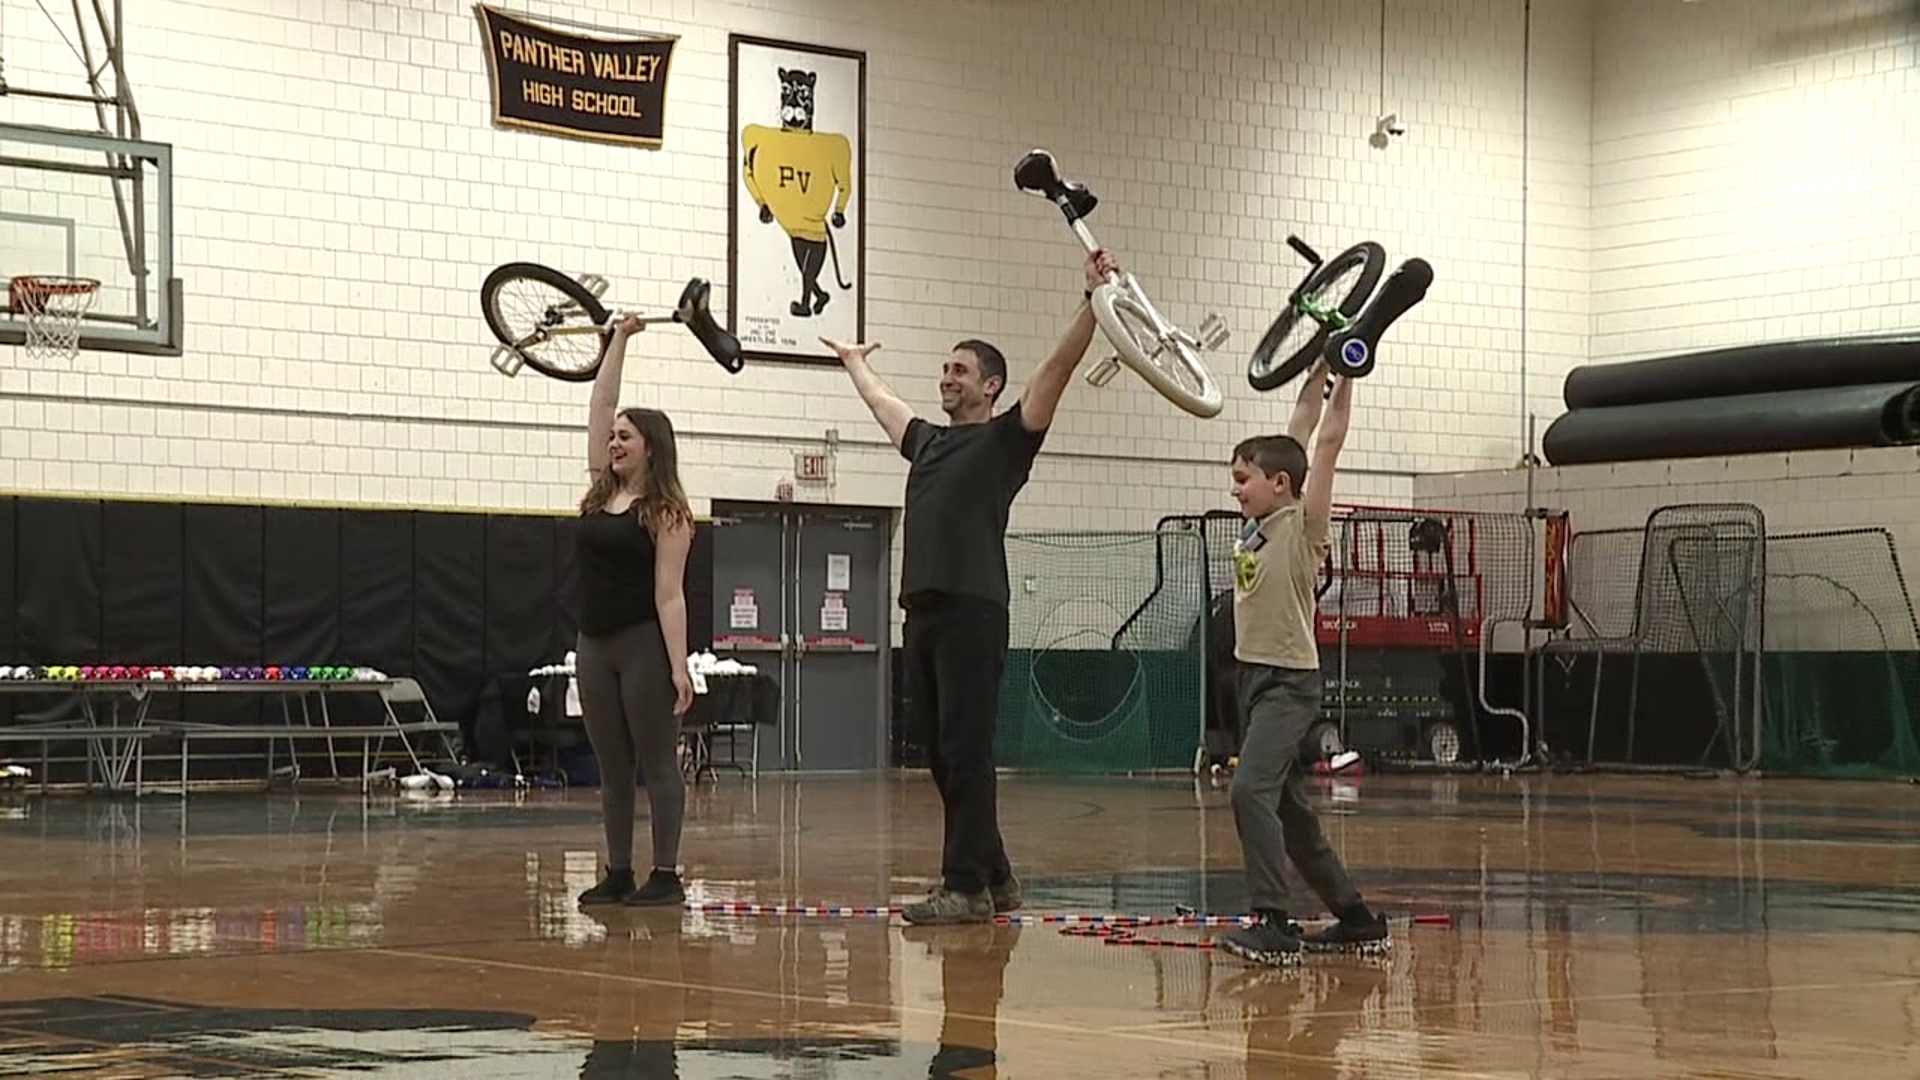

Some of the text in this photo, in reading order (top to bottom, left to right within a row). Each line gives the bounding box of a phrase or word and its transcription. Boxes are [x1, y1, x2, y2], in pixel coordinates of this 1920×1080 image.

[500, 30, 661, 82] PANTHER VALLEY
[522, 79, 642, 118] HIGH SCHOOL
[779, 165, 811, 193] PV
[803, 455, 826, 476] EXIT
